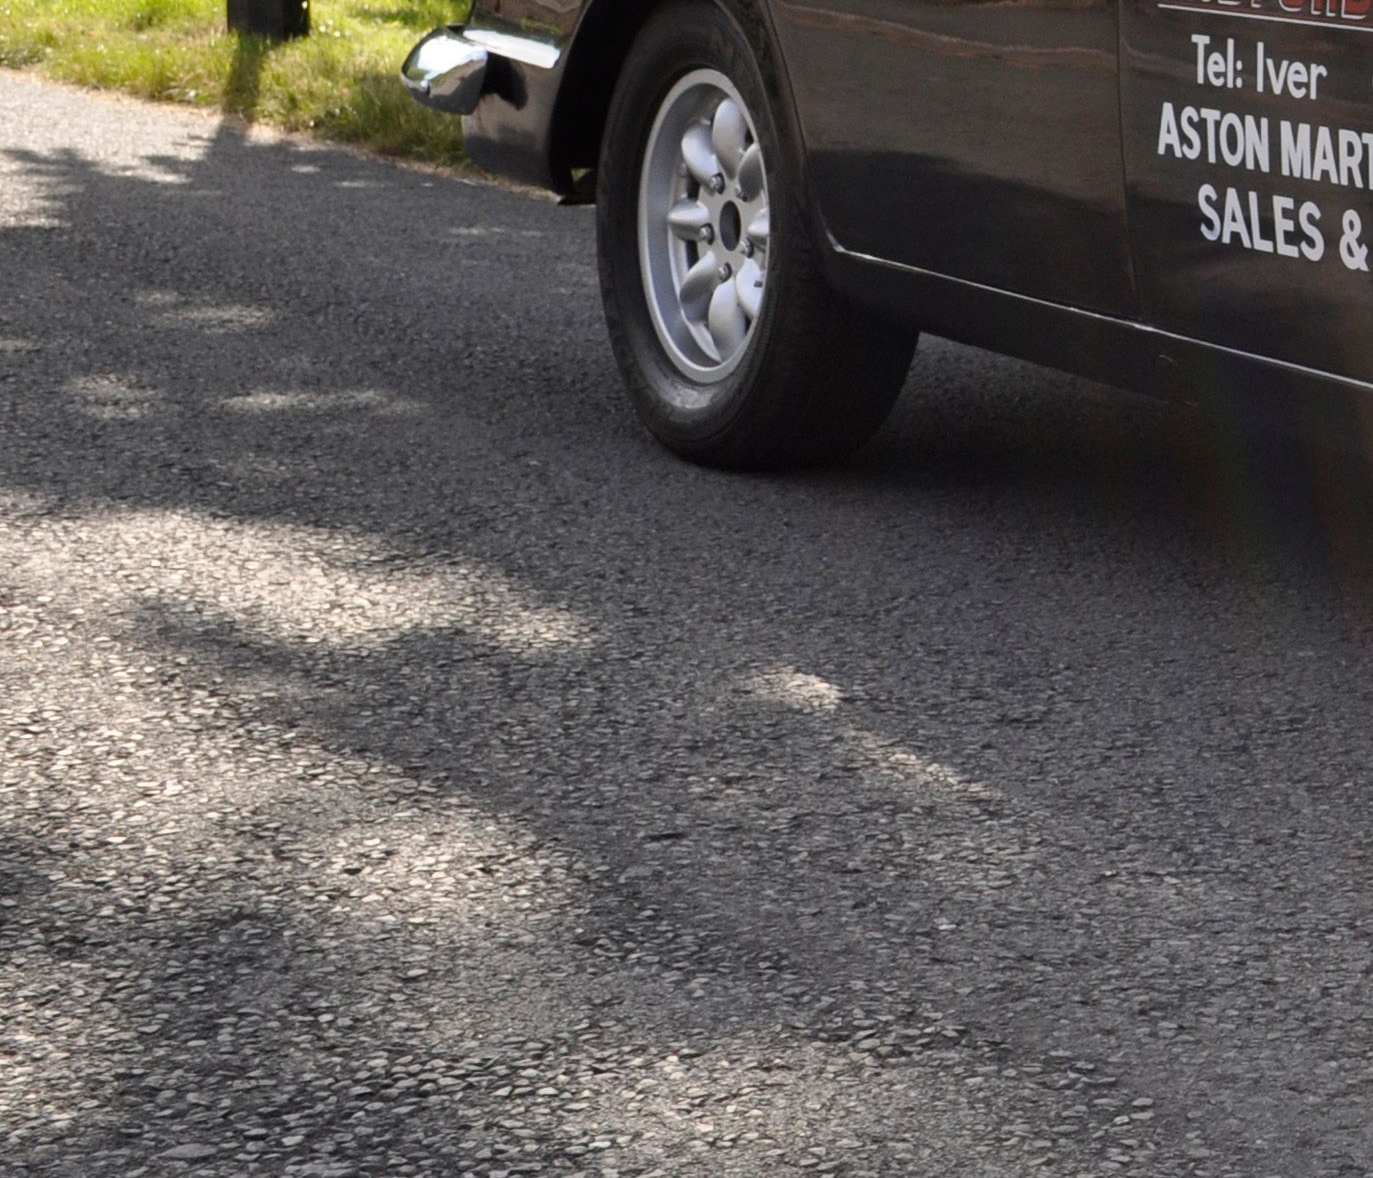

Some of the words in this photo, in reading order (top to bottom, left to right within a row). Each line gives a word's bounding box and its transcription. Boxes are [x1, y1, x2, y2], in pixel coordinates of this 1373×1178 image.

[1191, 33, 1243, 89] Tel:
[1256, 41, 1328, 100] Iver
[1157, 101, 1270, 173] ASTON
[1197, 183, 1325, 262] SALES
[1339, 209, 1369, 272] &
